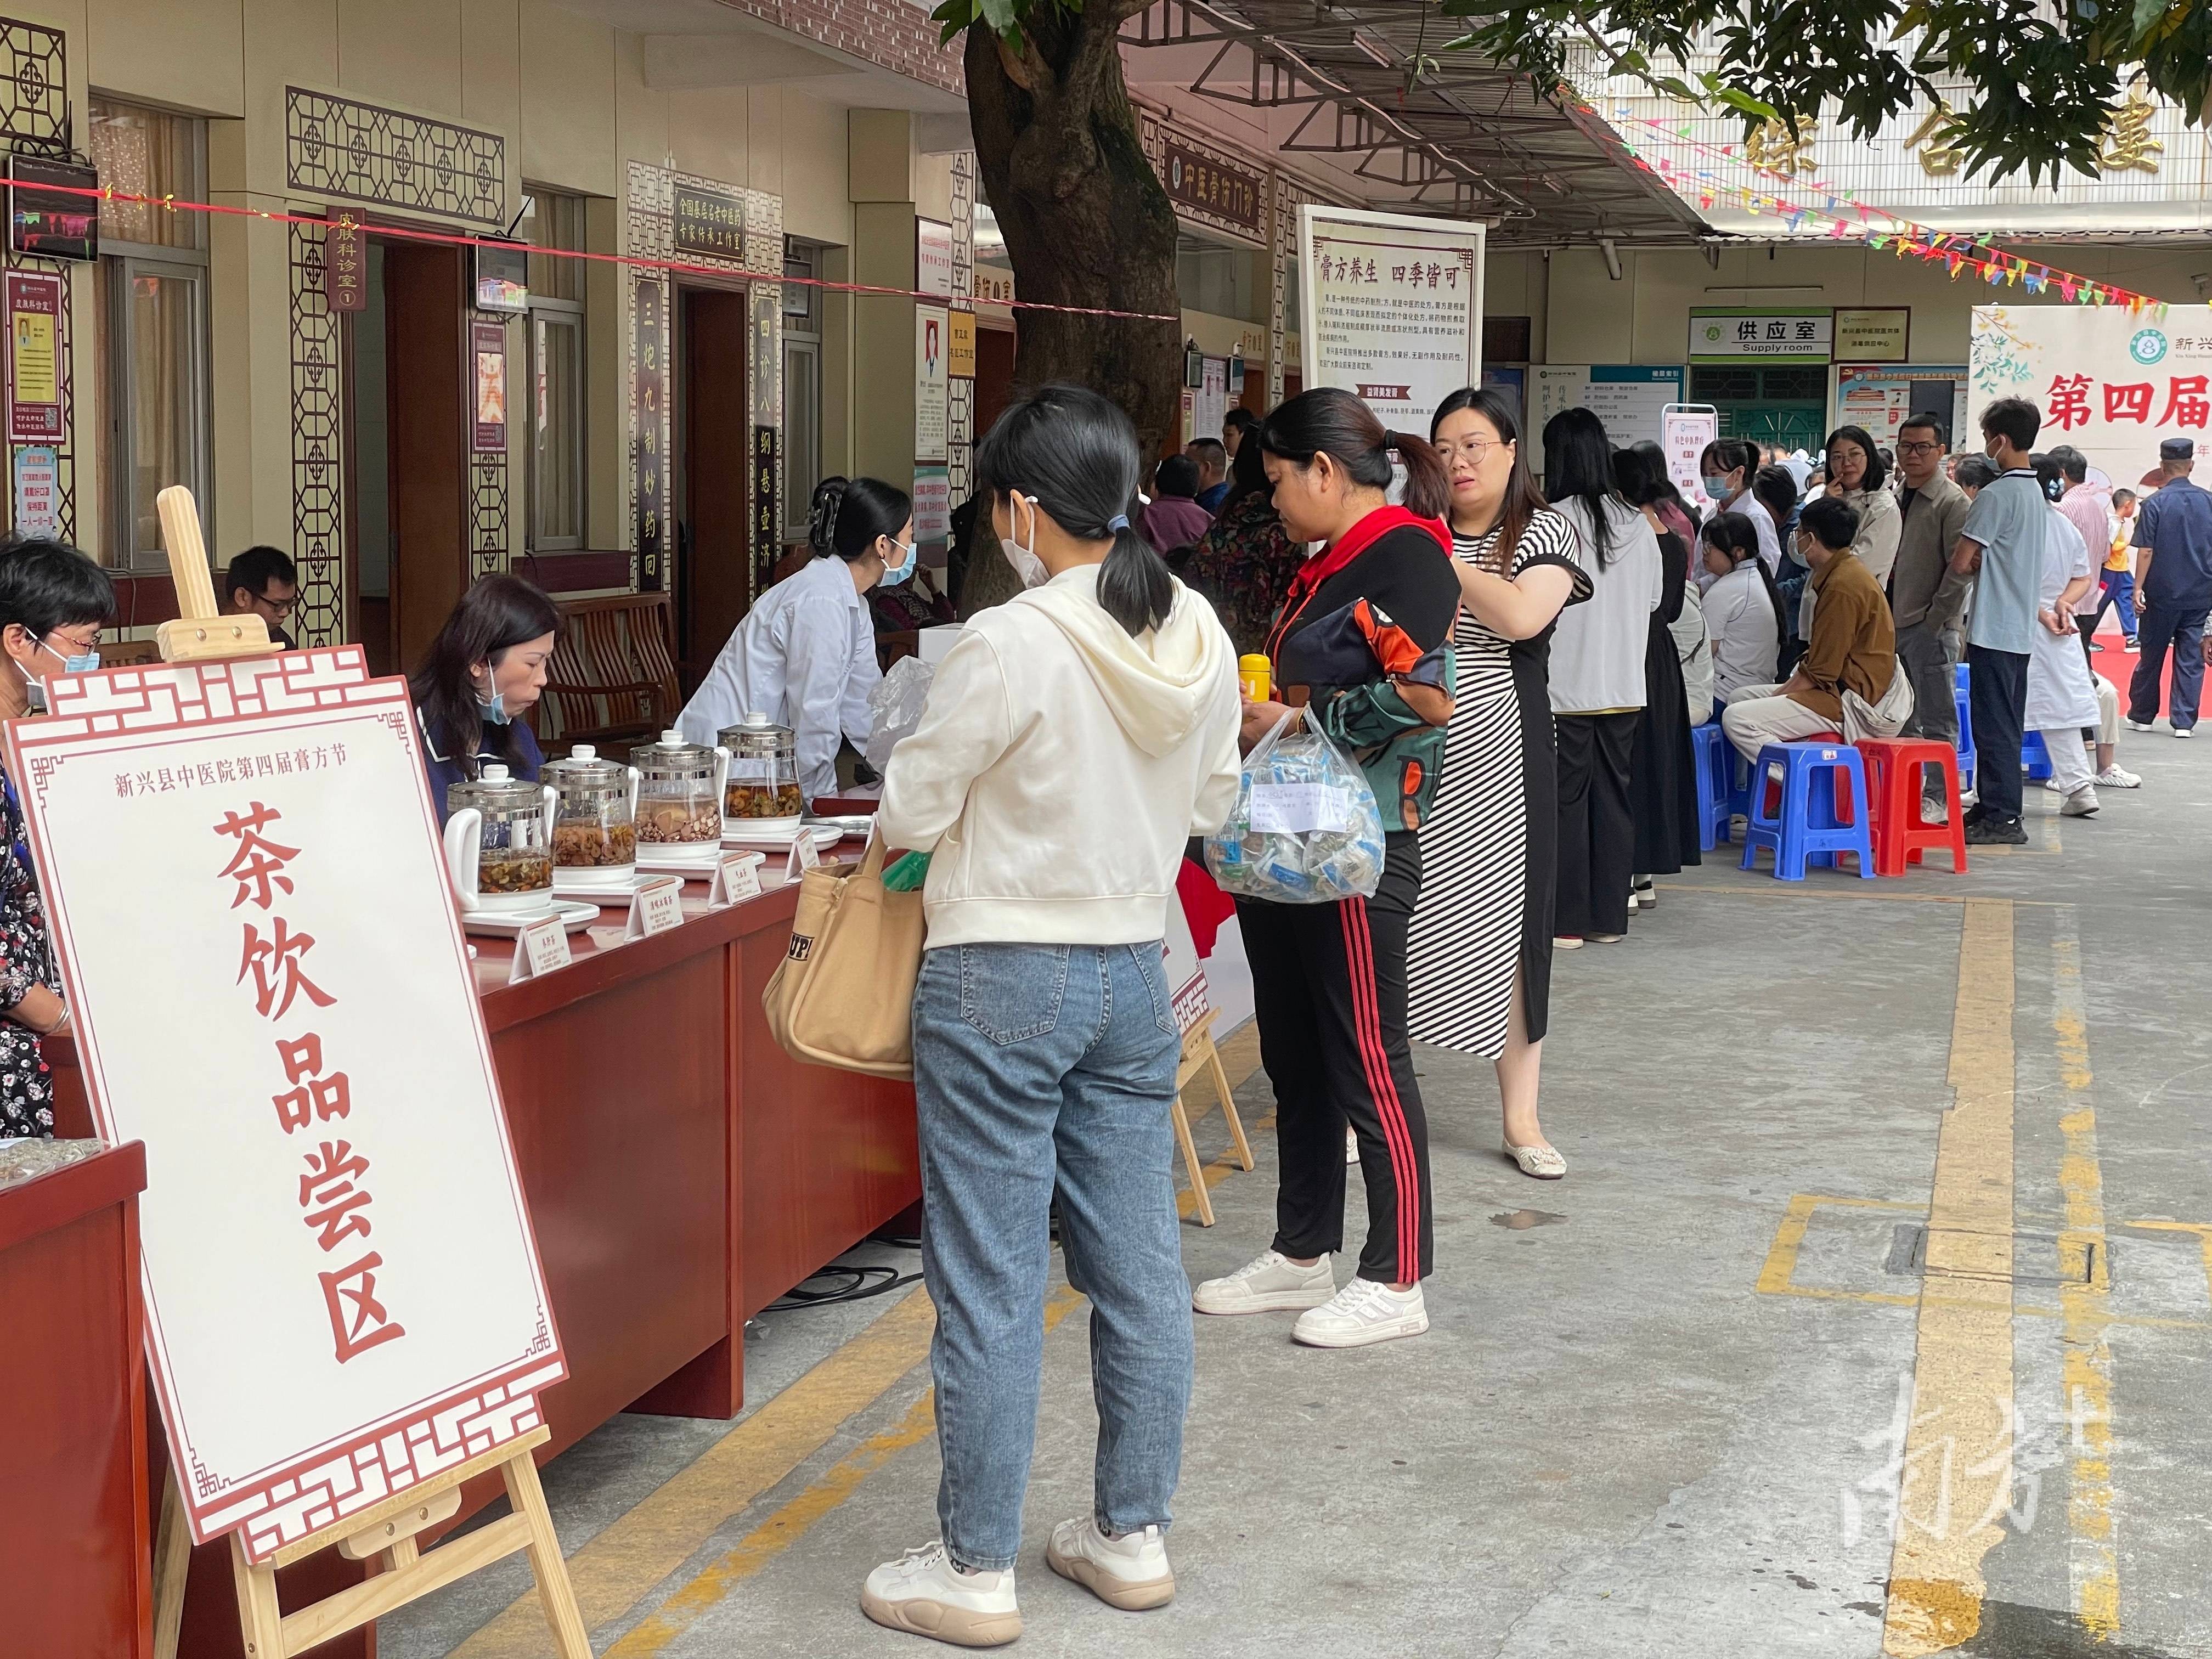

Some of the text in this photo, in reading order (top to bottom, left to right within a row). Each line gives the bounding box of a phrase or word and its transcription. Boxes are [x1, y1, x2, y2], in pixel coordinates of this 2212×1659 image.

[1185, 162, 1253, 218] 中医骨伤门诊
[680, 198, 741, 227] 全国基层名老中医药
[680, 222, 741, 250] 专家传承工作室
[1321, 254, 1460, 290] 膏方养生 四季皆可
[1737, 321, 1815, 340] 供应室
[1743, 343, 1780, 352] Supply
[1367, 387, 1398, 398] 益肾美发膏
[2041, 373, 2211, 431] 第四届
[114, 742, 347, 798] 新兴县中医院第四届膏方节
[789, 934, 813, 958] UP!
[212, 801, 405, 1364] 茶饮品尝区
